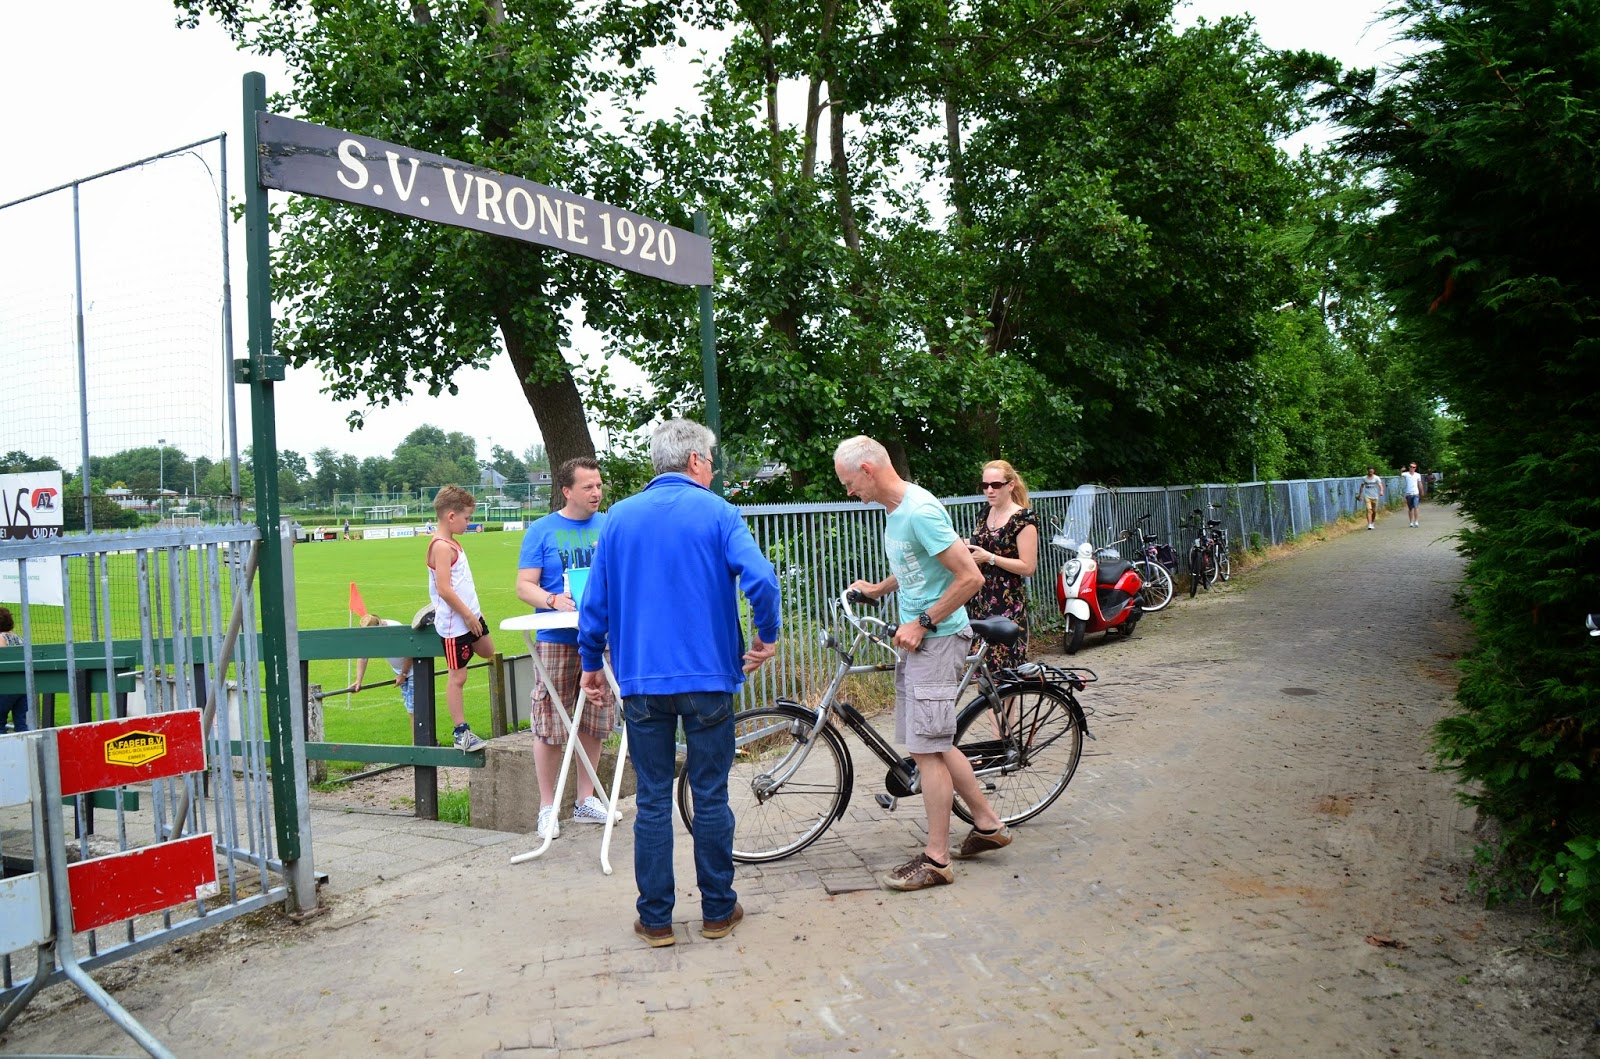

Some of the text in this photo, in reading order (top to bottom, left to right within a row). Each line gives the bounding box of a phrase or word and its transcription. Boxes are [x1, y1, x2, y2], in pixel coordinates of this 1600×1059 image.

[336, 139, 677, 266] S.V. VRONE 1920
[119, 738, 146, 748] FABER
[148, 736, 163, 745] B.V.
